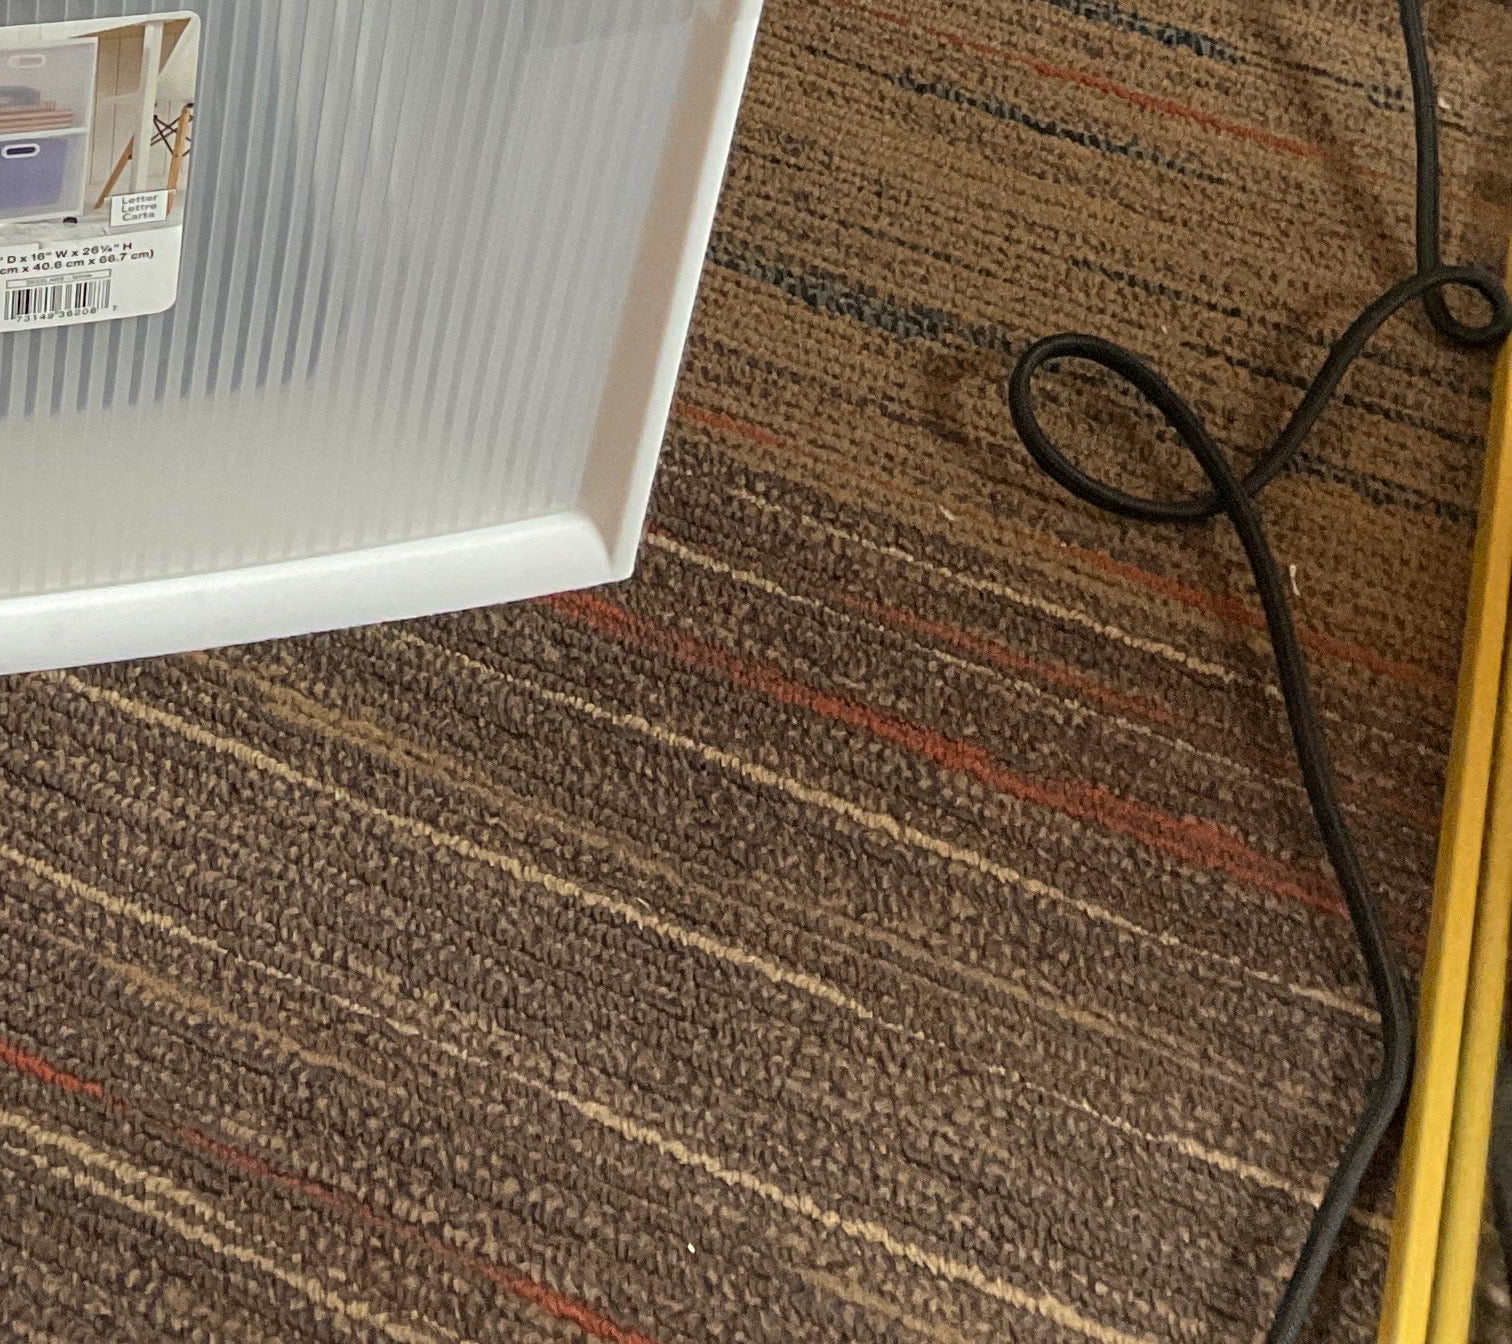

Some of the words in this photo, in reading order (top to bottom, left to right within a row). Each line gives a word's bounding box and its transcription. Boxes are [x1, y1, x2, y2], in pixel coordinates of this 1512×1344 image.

[121, 195, 158, 205] Letter
[122, 212, 155, 221] Carta
[7, 255, 16, 264] D
[55, 250, 68, 258] W
[123, 242, 133, 251] H
[0, 266, 18, 275] cm
[65, 259, 85, 268] cm
